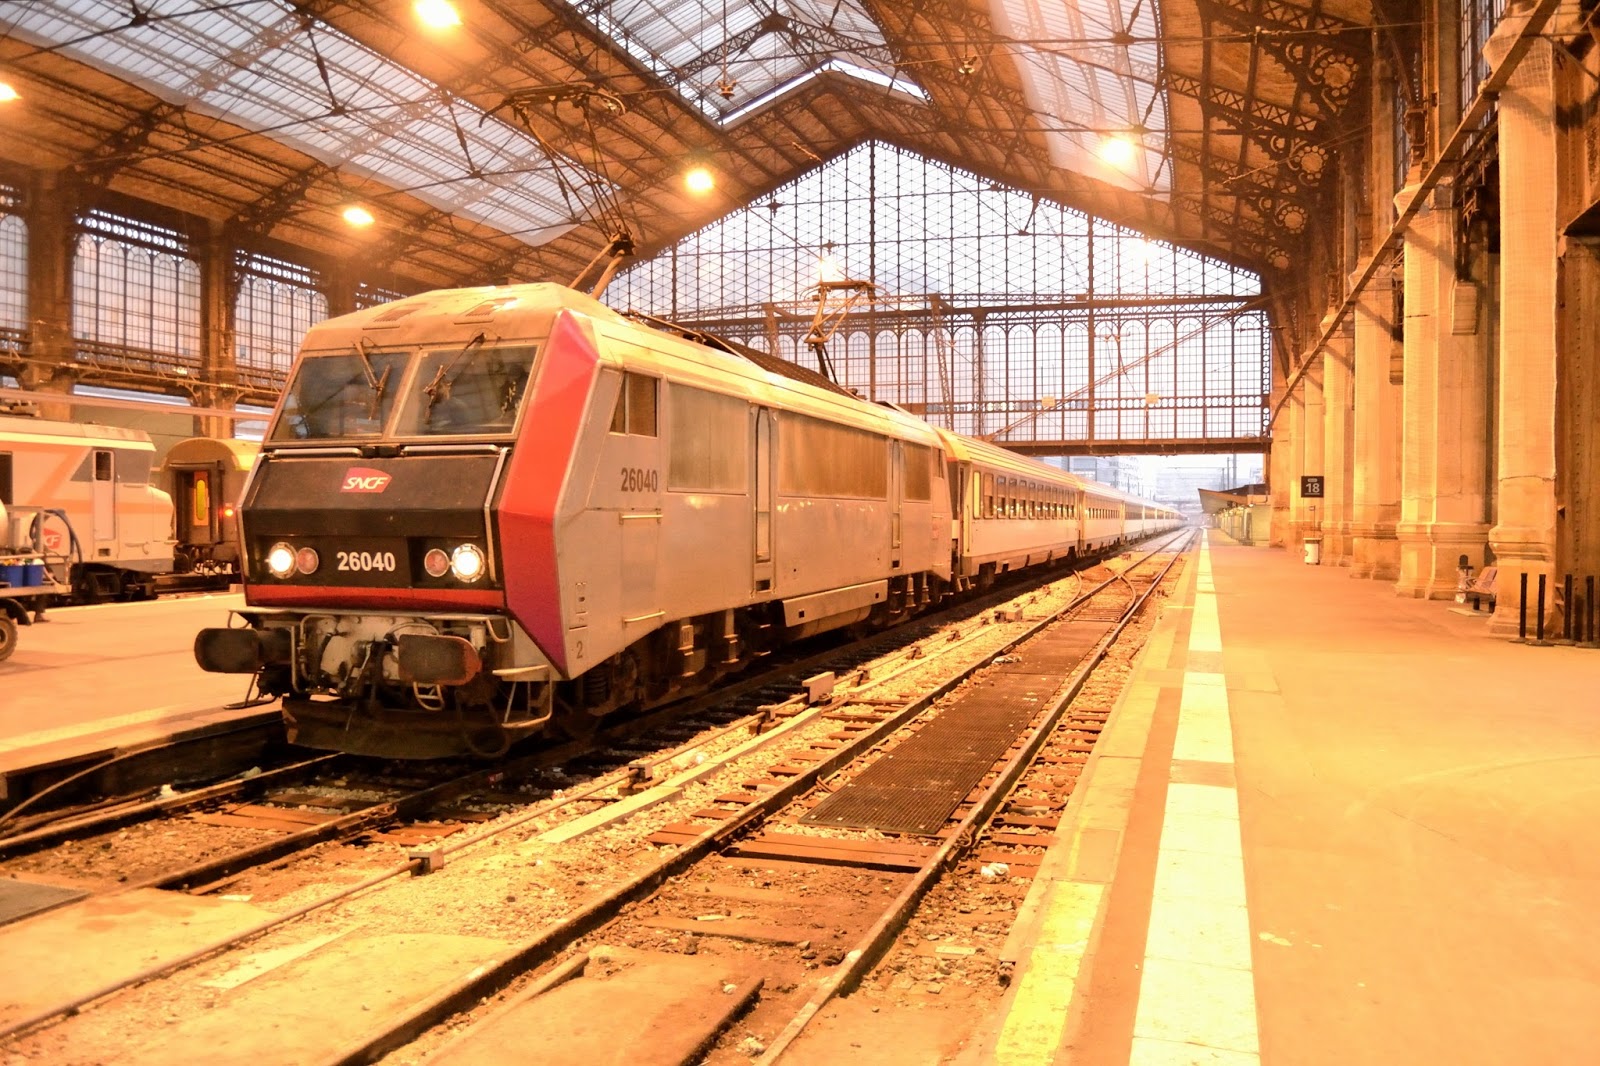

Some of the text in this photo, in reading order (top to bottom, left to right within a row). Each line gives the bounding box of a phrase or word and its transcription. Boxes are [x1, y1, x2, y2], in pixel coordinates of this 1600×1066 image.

[343, 476, 388, 490] SNCF
[621, 467, 658, 492] 26040
[1305, 482, 1320, 493] 18
[336, 551, 396, 572] 26040
[576, 640, 584, 659] 2
